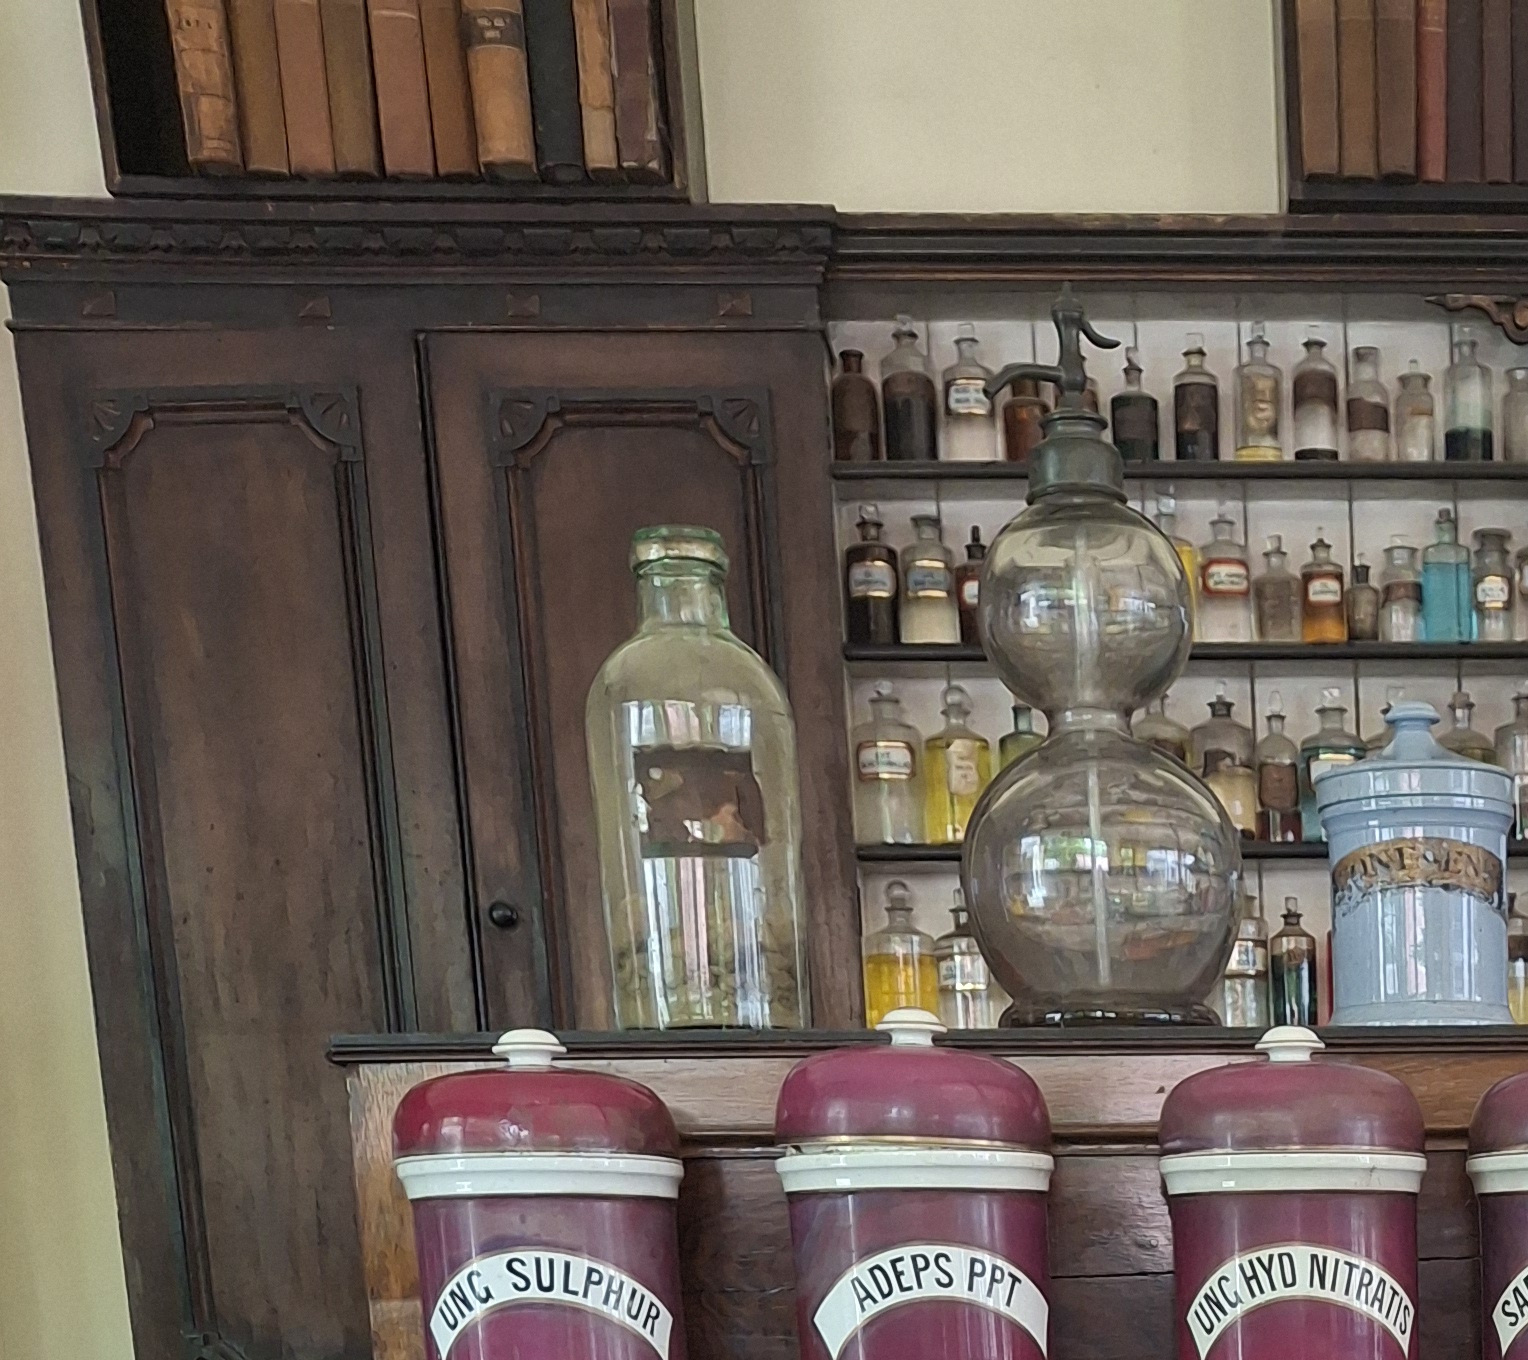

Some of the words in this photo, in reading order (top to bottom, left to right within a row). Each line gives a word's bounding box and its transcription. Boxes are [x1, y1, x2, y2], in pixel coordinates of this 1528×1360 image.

[439, 1268, 493, 1334] UNG
[505, 1257, 661, 1338] SULPHUR
[849, 1251, 953, 1314] ADEPS
[966, 1257, 1023, 1309] PPT
[1193, 1275, 1241, 1338] UNG
[1240, 1250, 1298, 1302] HYD
[1307, 1252, 1412, 1338] NITRATIS
